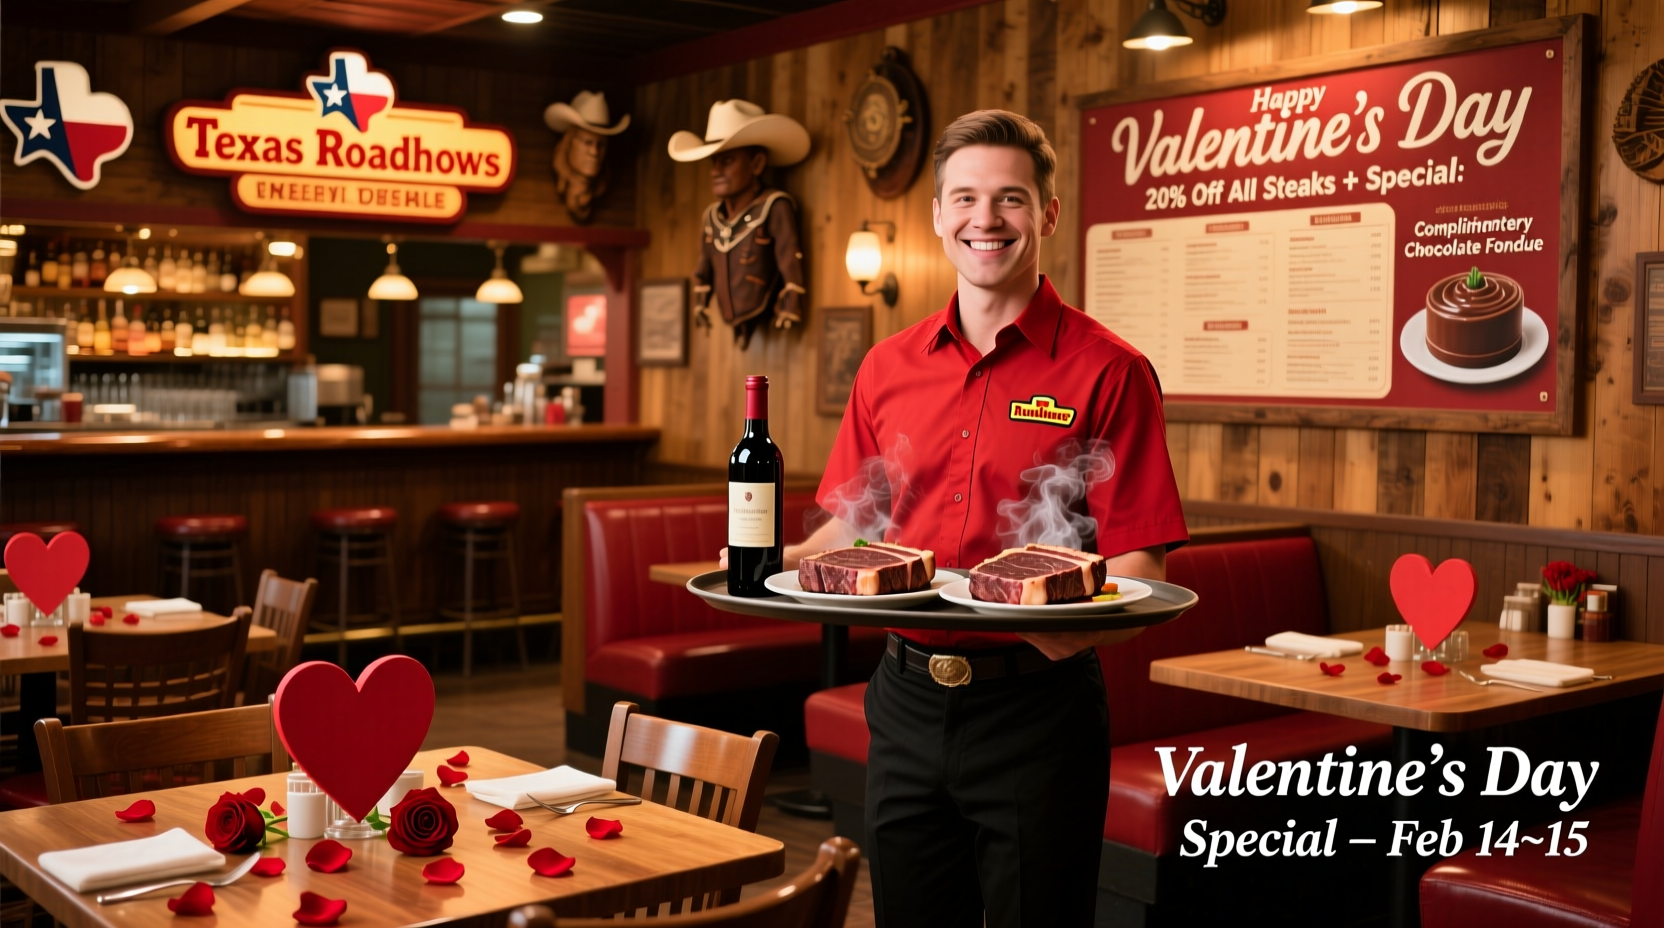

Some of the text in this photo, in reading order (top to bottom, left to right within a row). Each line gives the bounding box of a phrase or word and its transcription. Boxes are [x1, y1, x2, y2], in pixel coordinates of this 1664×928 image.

[1111, 71, 1533, 186] Valentine’s Day
[1249, 84, 1327, 118] Happy
[185, 116, 501, 178] Texas Roadhows
[1145, 156, 1465, 211] 20% Off All Steaks + Special:
[1404, 234, 1544, 258] Chocolate Fondue
